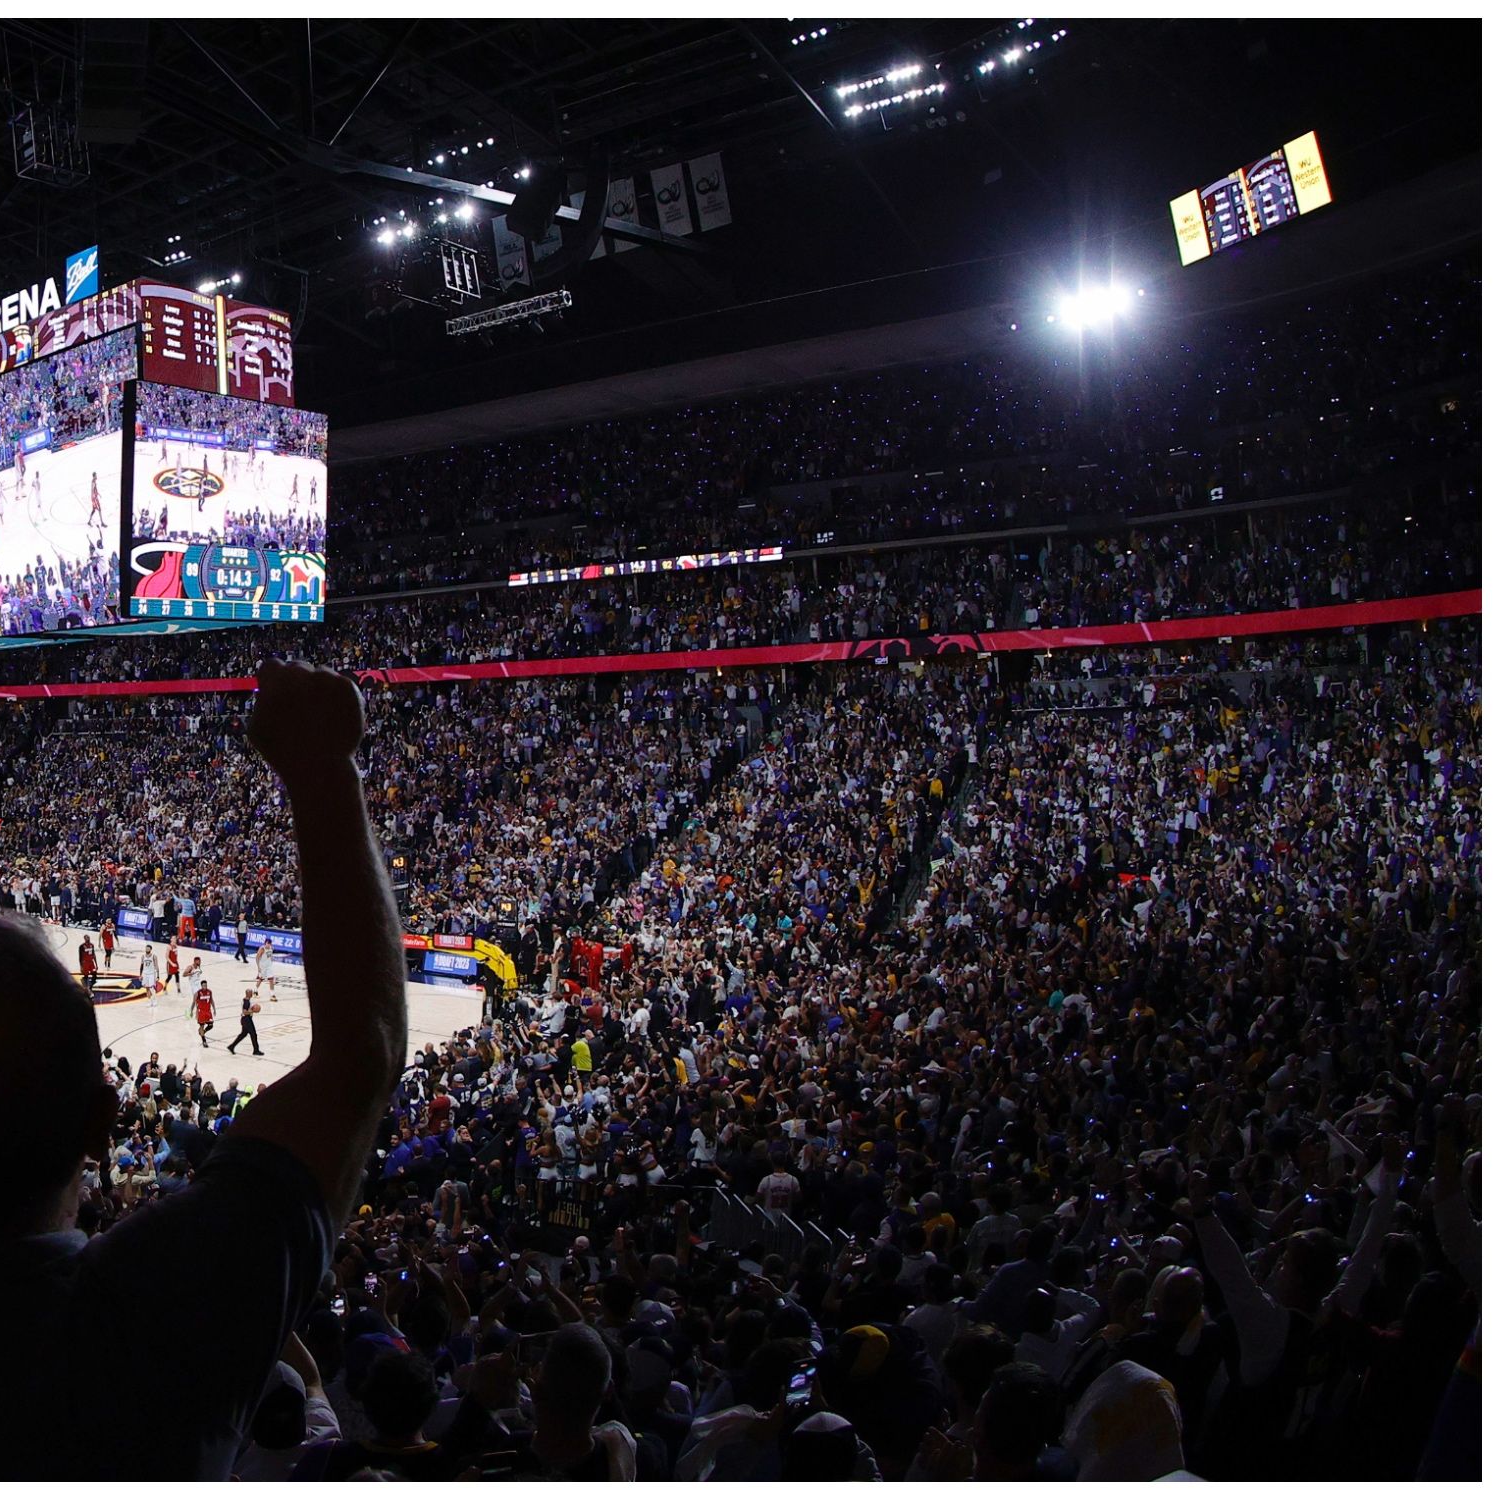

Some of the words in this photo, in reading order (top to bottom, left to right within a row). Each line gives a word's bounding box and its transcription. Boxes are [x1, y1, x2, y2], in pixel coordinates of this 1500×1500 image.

[66, 250, 98, 296] Ball
[186, 562, 198, 576] 89
[217, 568, 252, 586] 0:14.3
[270, 568, 281, 581] 92
[284, 938, 294, 948] 22
[439, 954, 455, 968] DRAFT
[455, 957, 470, 970] 2023
